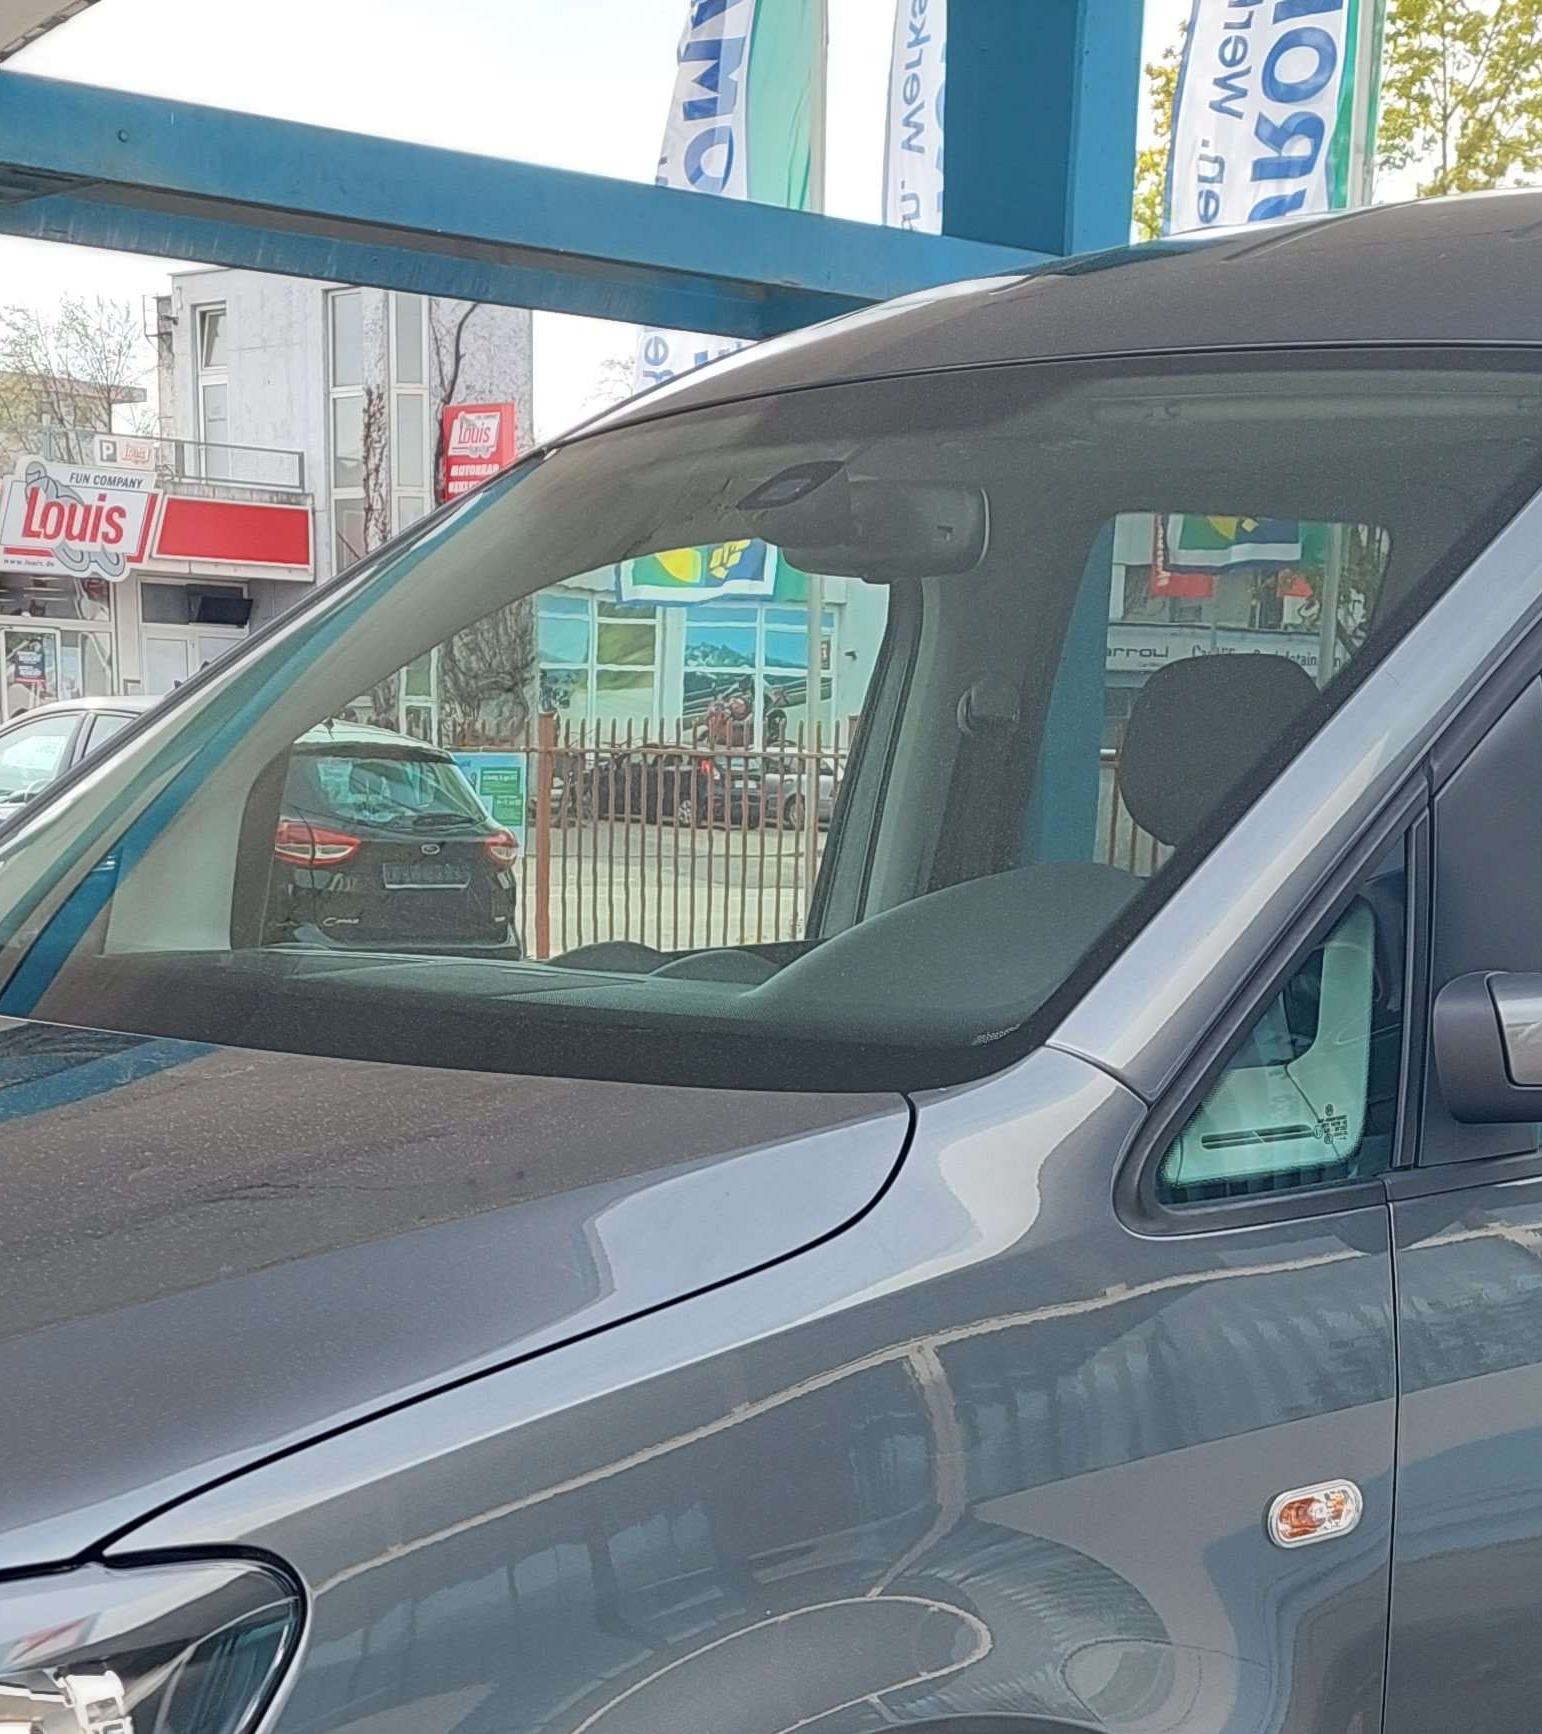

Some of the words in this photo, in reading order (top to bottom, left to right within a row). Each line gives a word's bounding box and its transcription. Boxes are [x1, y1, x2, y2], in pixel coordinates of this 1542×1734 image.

[458, 422, 492, 444] Louis
[69, 472, 90, 485] FUN
[93, 474, 144, 489] COMPANY
[21, 486, 127, 545] Louis
